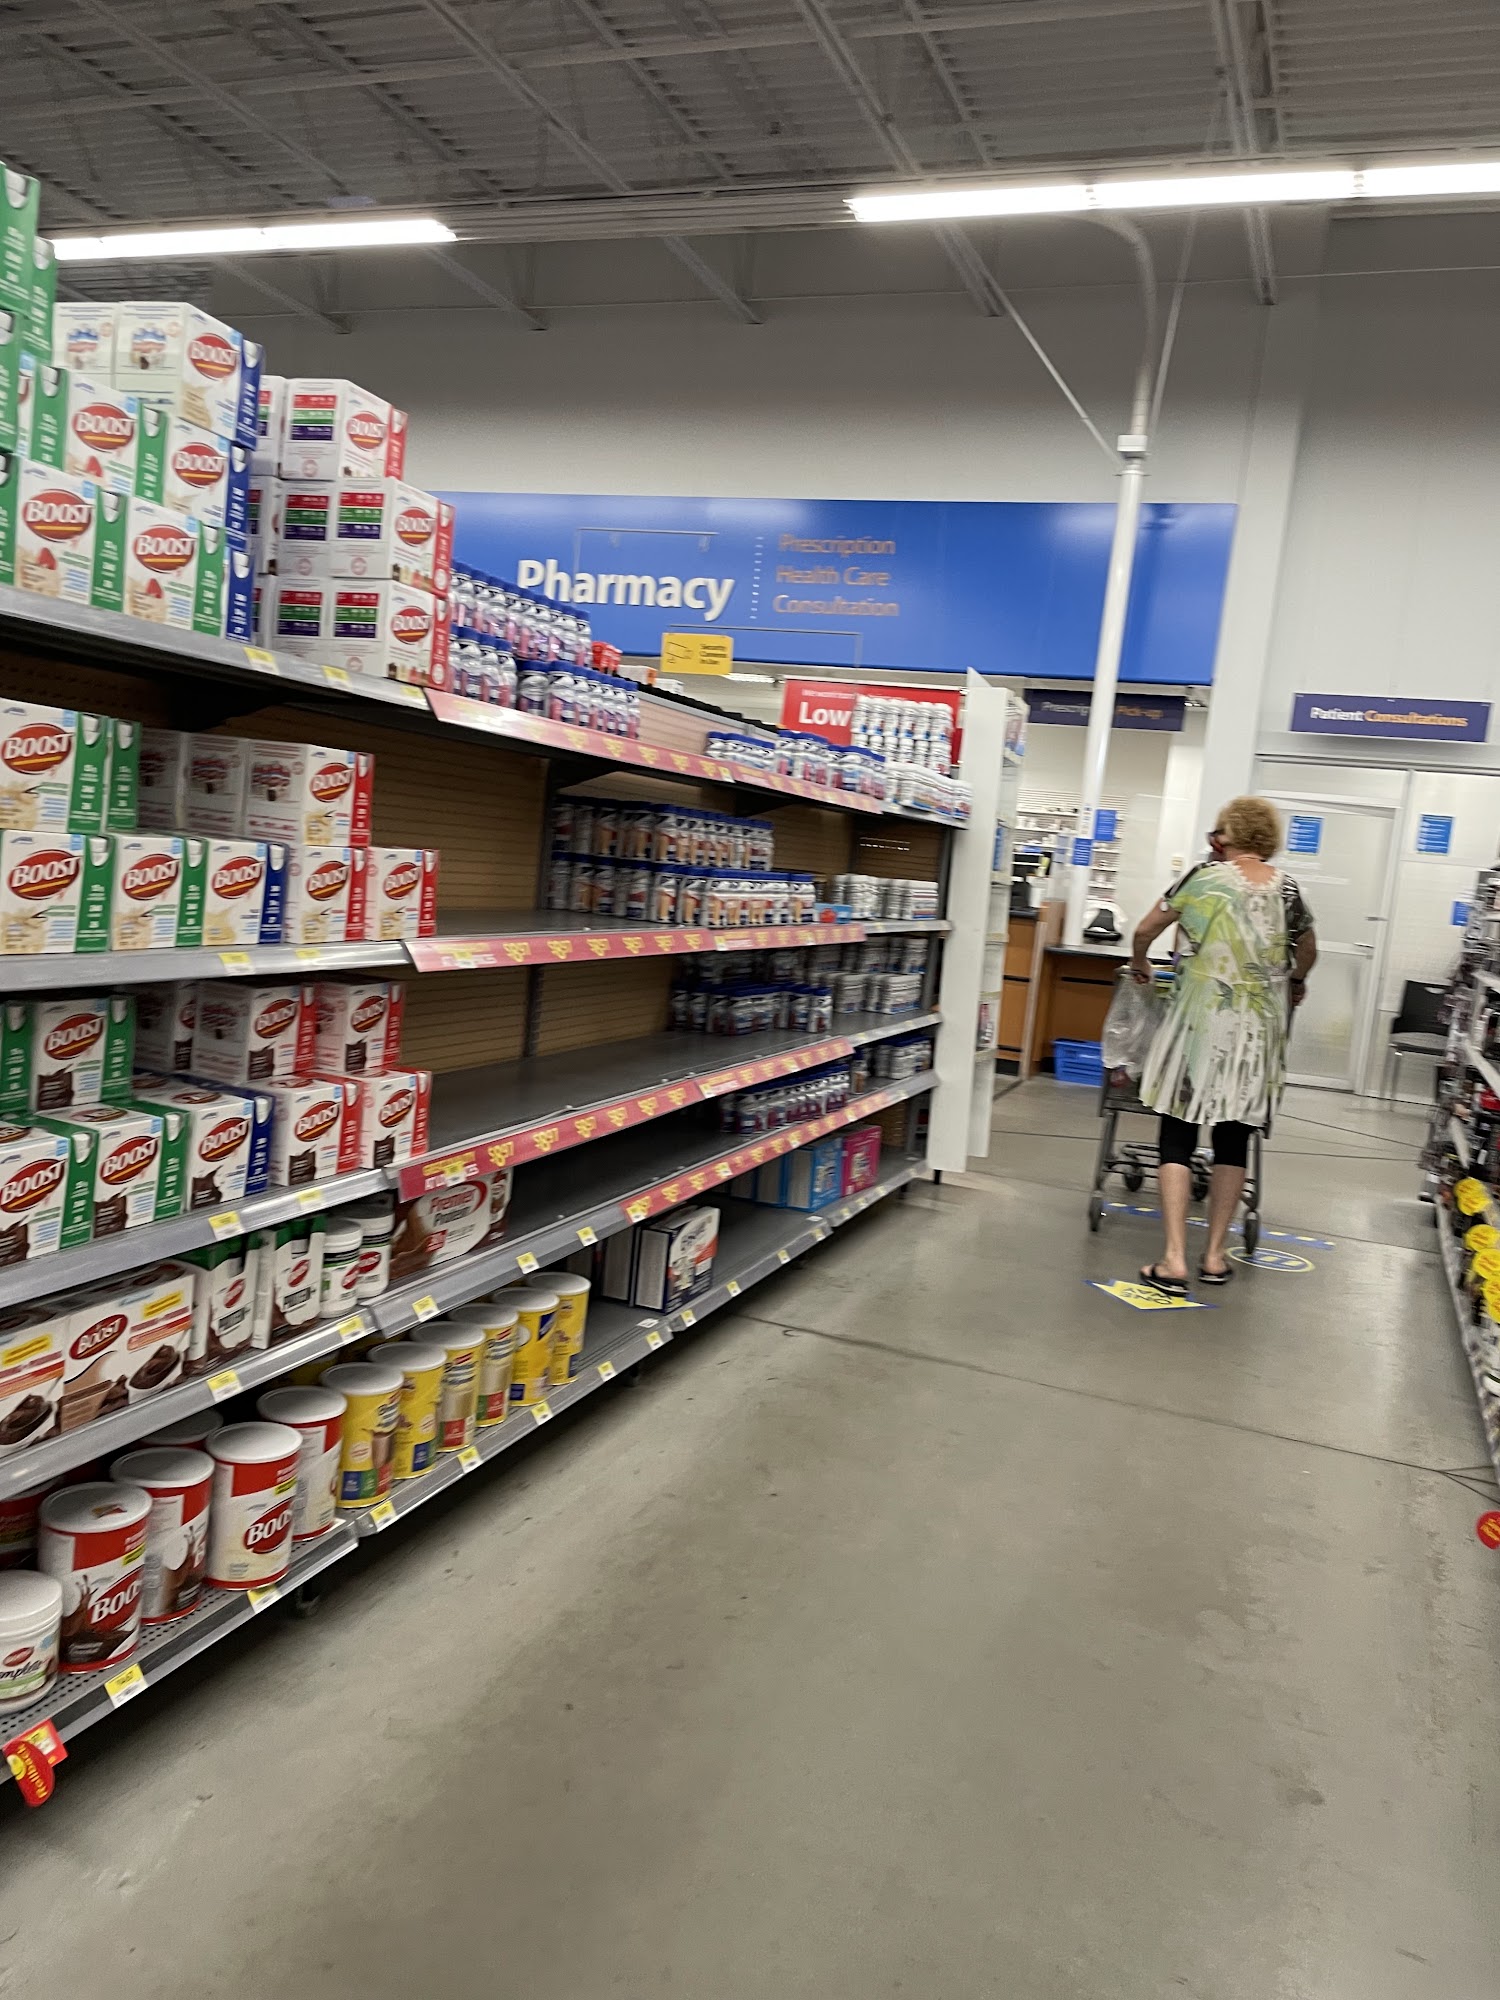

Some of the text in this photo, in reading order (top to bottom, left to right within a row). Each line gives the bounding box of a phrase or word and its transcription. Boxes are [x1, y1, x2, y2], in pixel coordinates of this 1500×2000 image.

[191, 341, 239, 366] BOOST
[75, 415, 136, 437] BOOST
[175, 451, 227, 473] BOOST
[25, 502, 95, 523] BOOST
[136, 537, 198, 556] BOOST
[778, 533, 896, 558] Prescription
[517, 558, 735, 622] Pharmacy
[775, 565, 891, 587] Health Care
[772, 594, 900, 617] Consultation
[1310, 706, 1469, 727] Patient Consultations
[2, 732, 75, 760] BOOST
[10, 855, 83, 888] BOOST
[123, 860, 180, 888] BOOST
[213, 861, 264, 889] BOOST
[48, 1015, 105, 1050] BOOST
[102, 1136, 161, 1178] BOOST
[0, 1159, 68, 1205] BOOST
[77, 1317, 124, 1355] BOOST
[247, 1509, 293, 1547] BOO
[91, 1580, 141, 1624] BOO
[16, 1742, 49, 1800] Rollback
